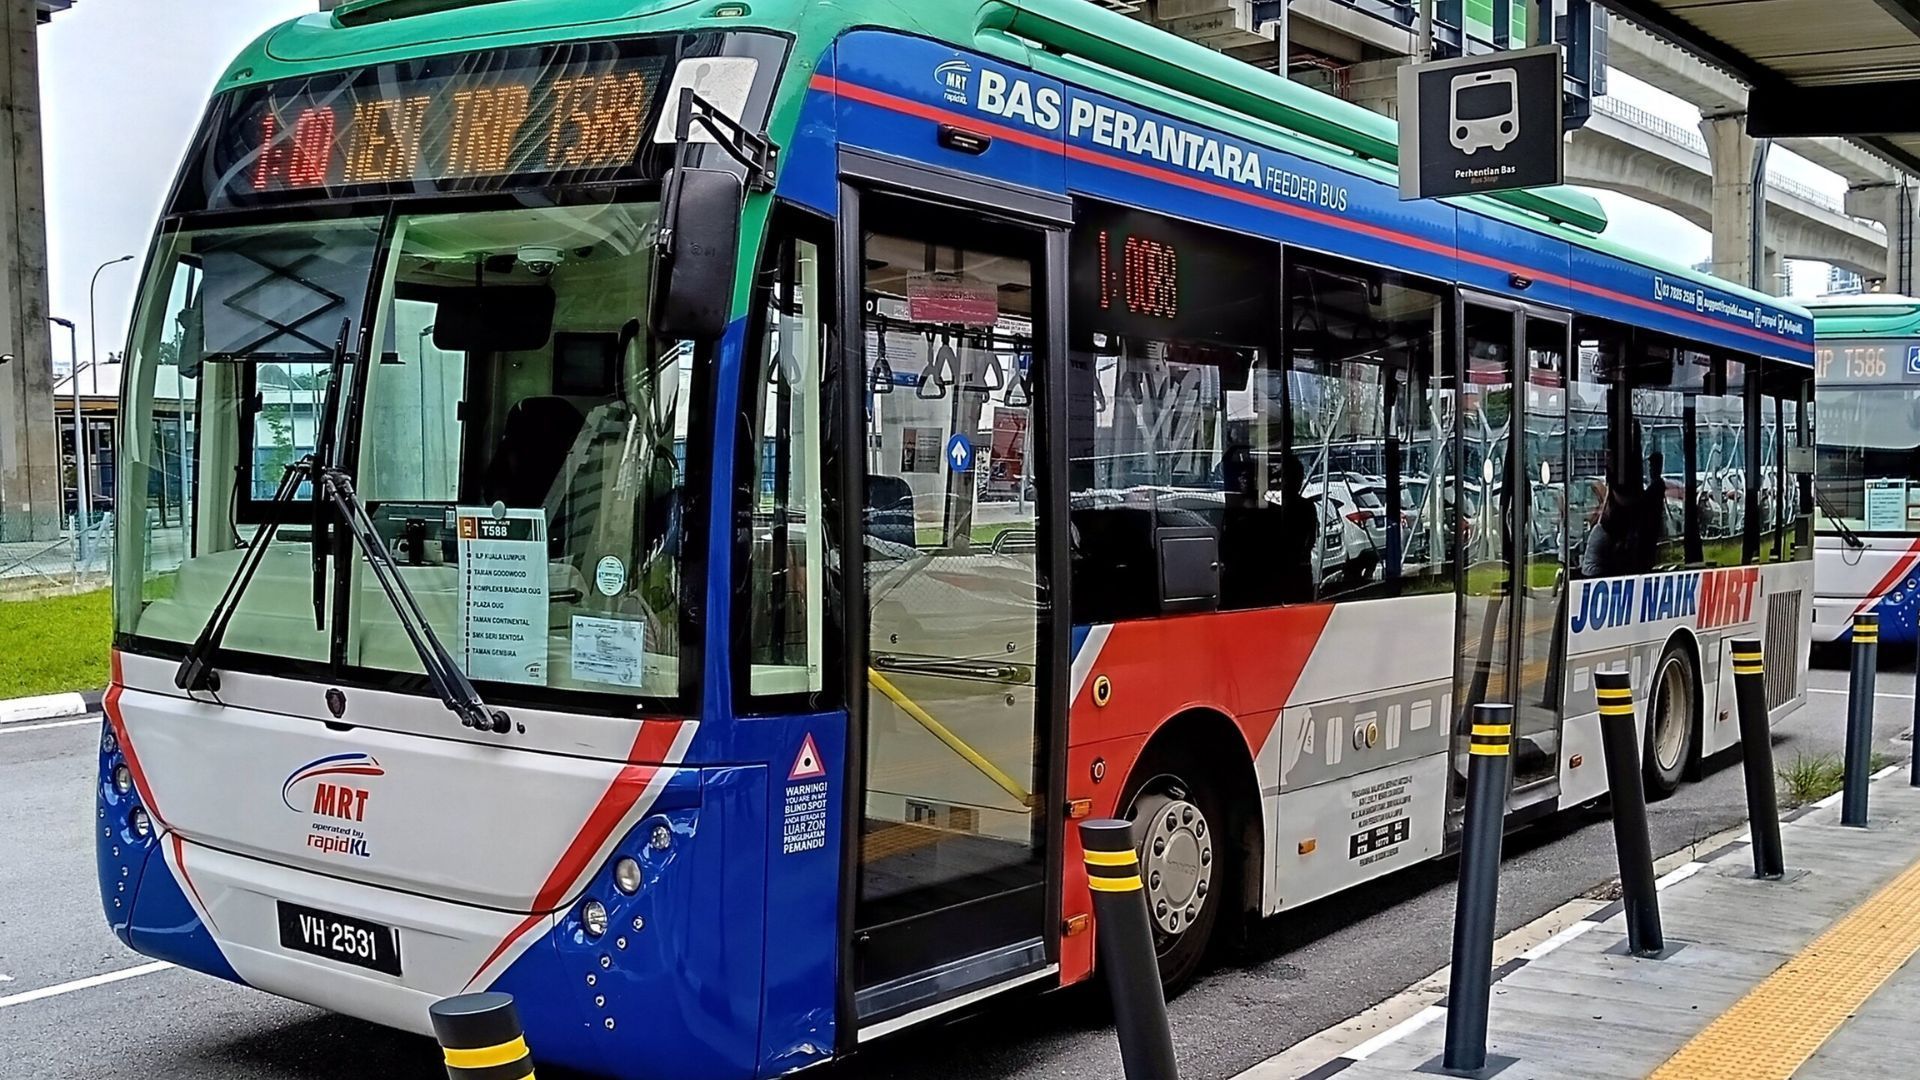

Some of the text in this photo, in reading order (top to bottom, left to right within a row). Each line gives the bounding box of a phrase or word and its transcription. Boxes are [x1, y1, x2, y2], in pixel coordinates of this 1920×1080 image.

[946, 72, 967, 90] MRT
[343, 95, 430, 183] NEXT
[448, 86, 529, 173] TRIP
[546, 71, 646, 168] T588
[977, 68, 1348, 212] BAS PERANTARA FEEDER BUS
[1455, 165, 1516, 179] Perhentian Bas
[1844, 348, 1887, 378] T586
[481, 525, 508, 537] T588
[1571, 567, 1760, 634] JOM NAIK MRT
[492, 617, 530, 626] CONTINENTAL
[498, 633, 524, 641] SENTOSA
[786, 782, 828, 797] WARNING!
[313, 783, 369, 822] MRT
[785, 796, 799, 804] YOU
[799, 794, 810, 802] ARE
[785, 799, 827, 814] BLIND SPOT
[784, 816, 799, 824] ANDA
[800, 813, 819, 822] BERADA
[312, 823, 364, 839] operated by
[784, 819, 826, 836] LUAR ZON
[783, 830, 825, 844] PENGLIHATAN
[307, 834, 370, 857] rapidKL
[783, 837, 825, 854] PEMANDU
[299, 913, 377, 961] VH 2531
